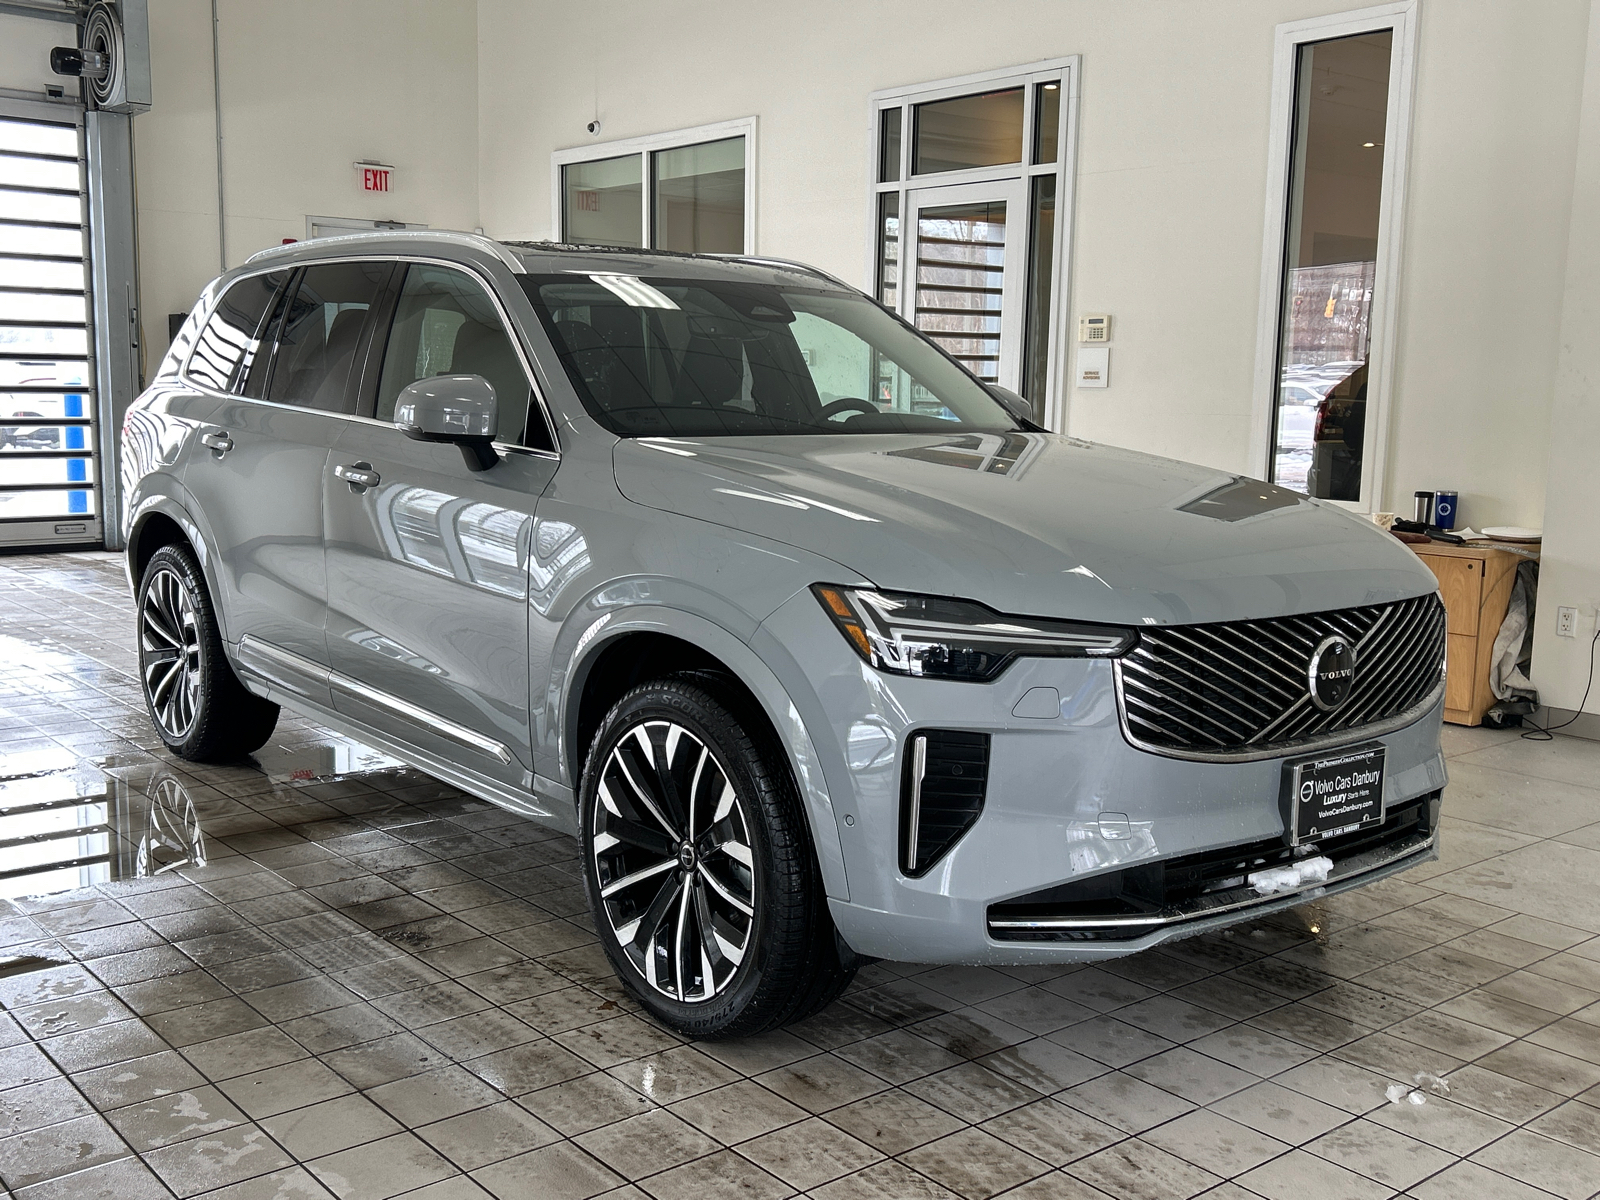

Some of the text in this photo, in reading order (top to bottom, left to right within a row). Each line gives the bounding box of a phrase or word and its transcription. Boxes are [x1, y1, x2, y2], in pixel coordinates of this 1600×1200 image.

[364, 168, 389, 192] EXIT
[1320, 668, 1352, 681] VOLVO
[1315, 770, 1380, 795] Volvo Cars Danbury
[1323, 792, 1347, 806] Luxury
[1318, 800, 1373, 819] VolvoCarsDanbury.com
